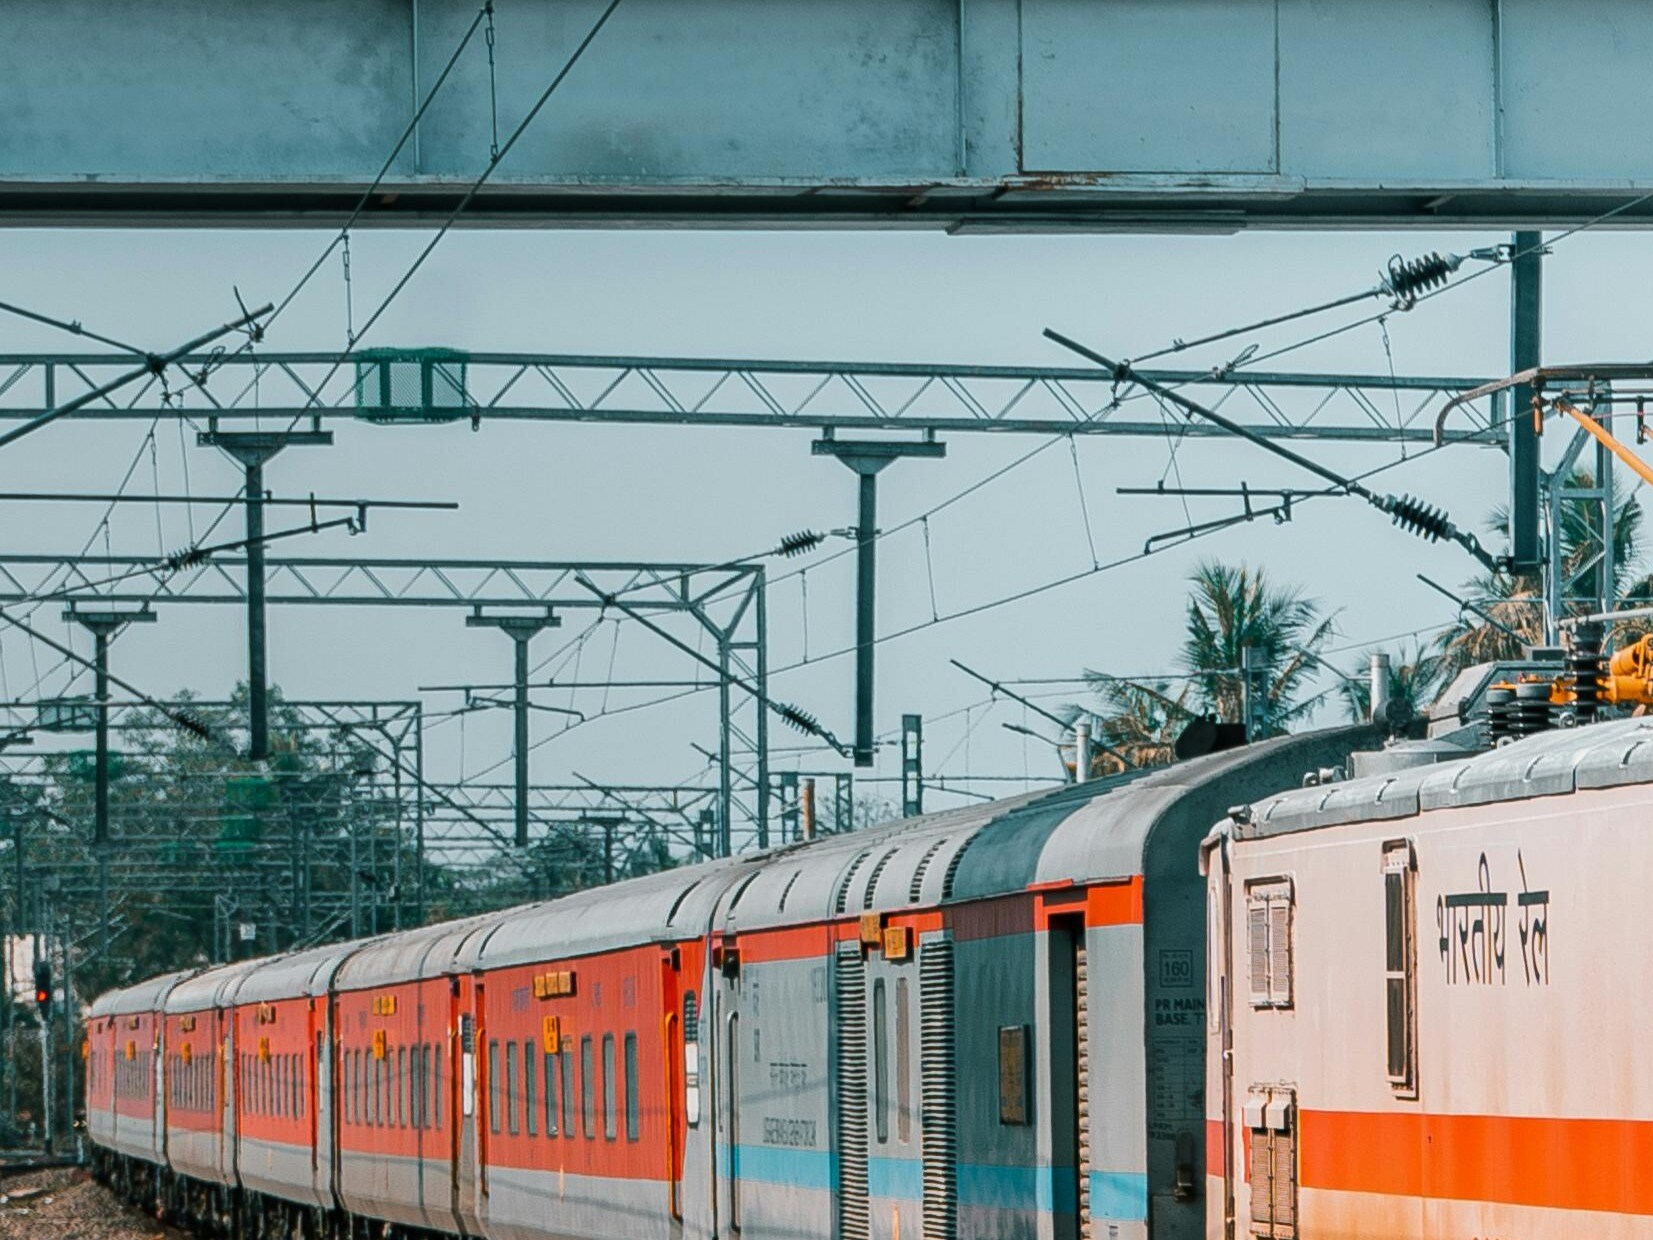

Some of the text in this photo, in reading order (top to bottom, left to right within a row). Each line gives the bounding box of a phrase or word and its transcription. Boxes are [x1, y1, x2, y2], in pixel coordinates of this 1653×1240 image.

[1436, 848, 1550, 987] भारतीय रेल
[1164, 961, 1189, 977] 160
[1155, 998, 1171, 1011] PR
